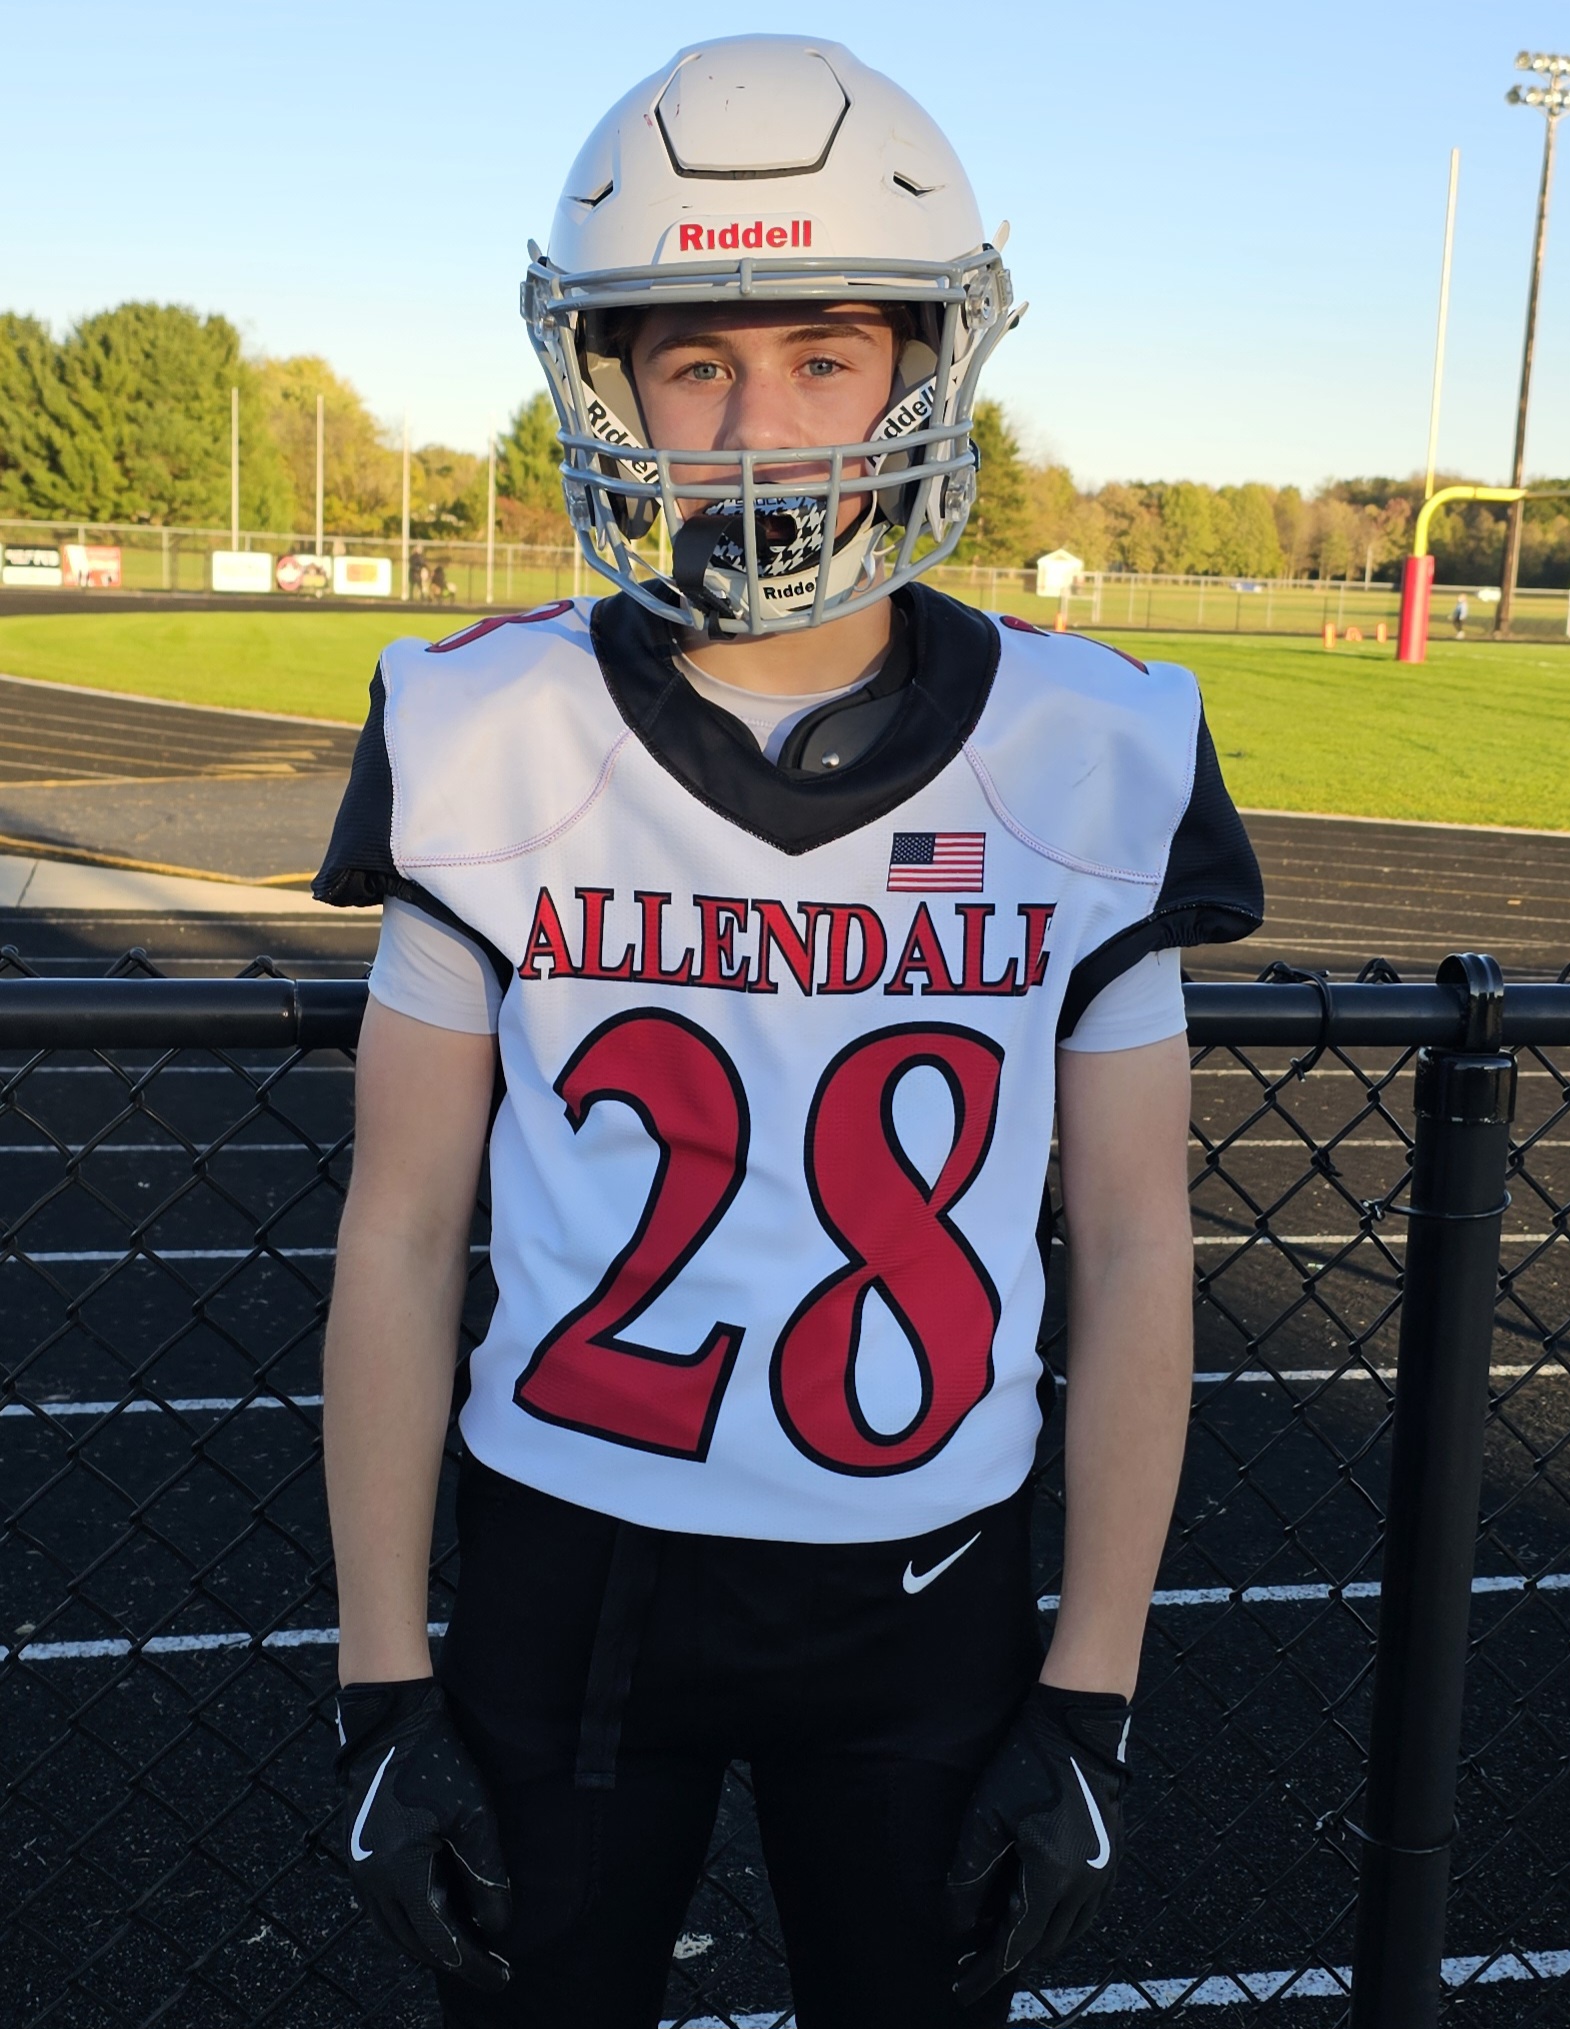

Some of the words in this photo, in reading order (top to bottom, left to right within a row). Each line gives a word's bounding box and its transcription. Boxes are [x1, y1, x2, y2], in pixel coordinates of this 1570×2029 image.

[679, 220, 812, 251] Riddell
[763, 576, 819, 600] Ridde
[512, 1006, 1006, 1477] 28
